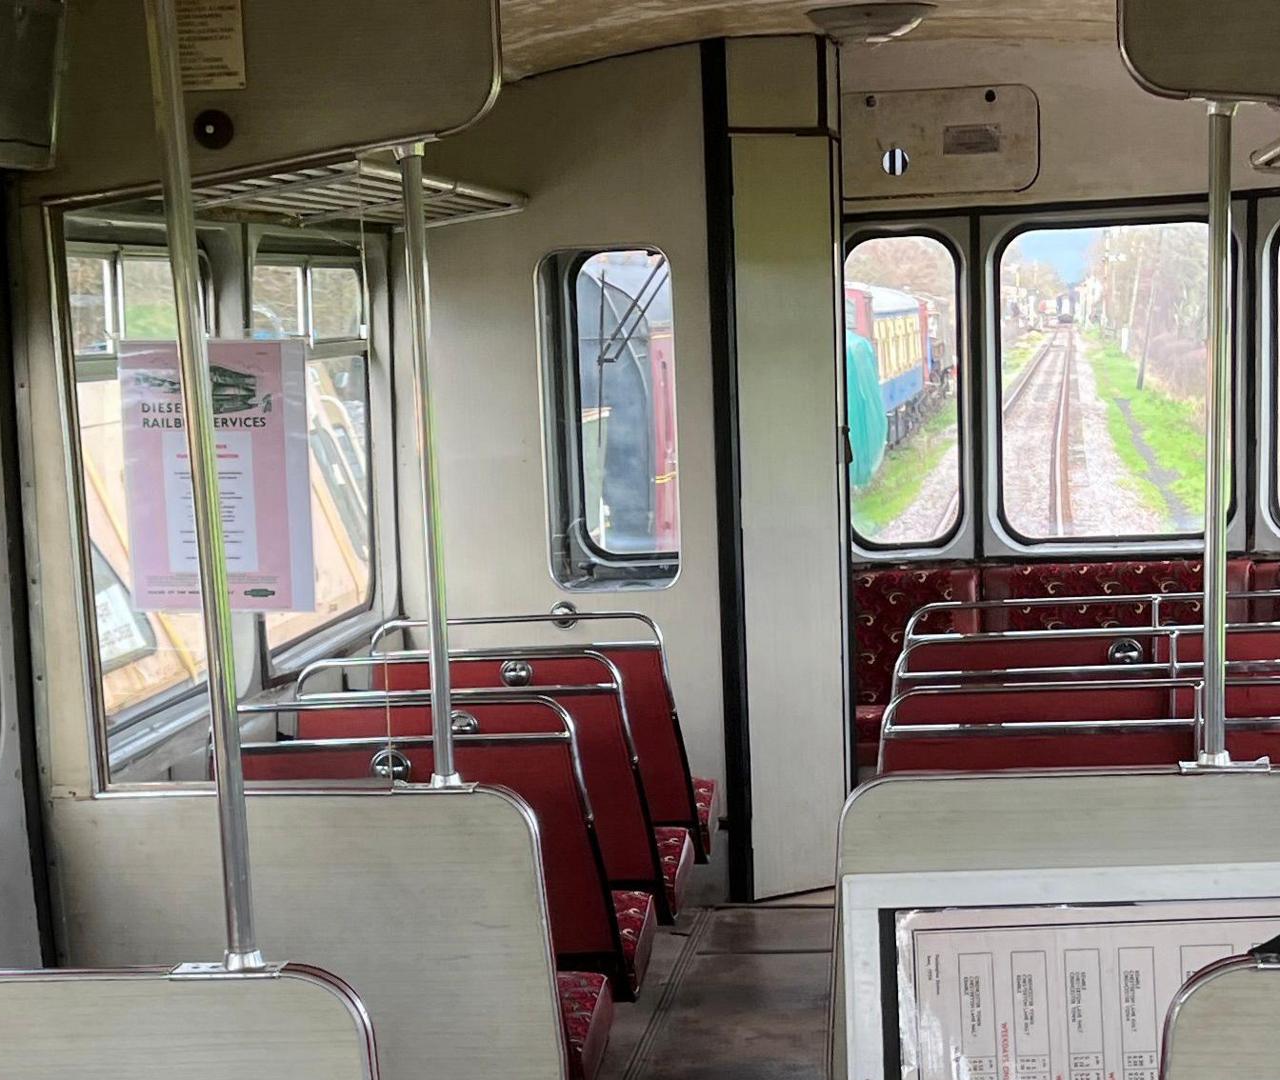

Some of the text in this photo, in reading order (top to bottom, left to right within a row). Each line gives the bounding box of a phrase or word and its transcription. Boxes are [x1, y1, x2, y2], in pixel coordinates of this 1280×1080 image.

[141, 402, 182, 413] DIESE
[142, 416, 267, 428] RAILB ERVICES
